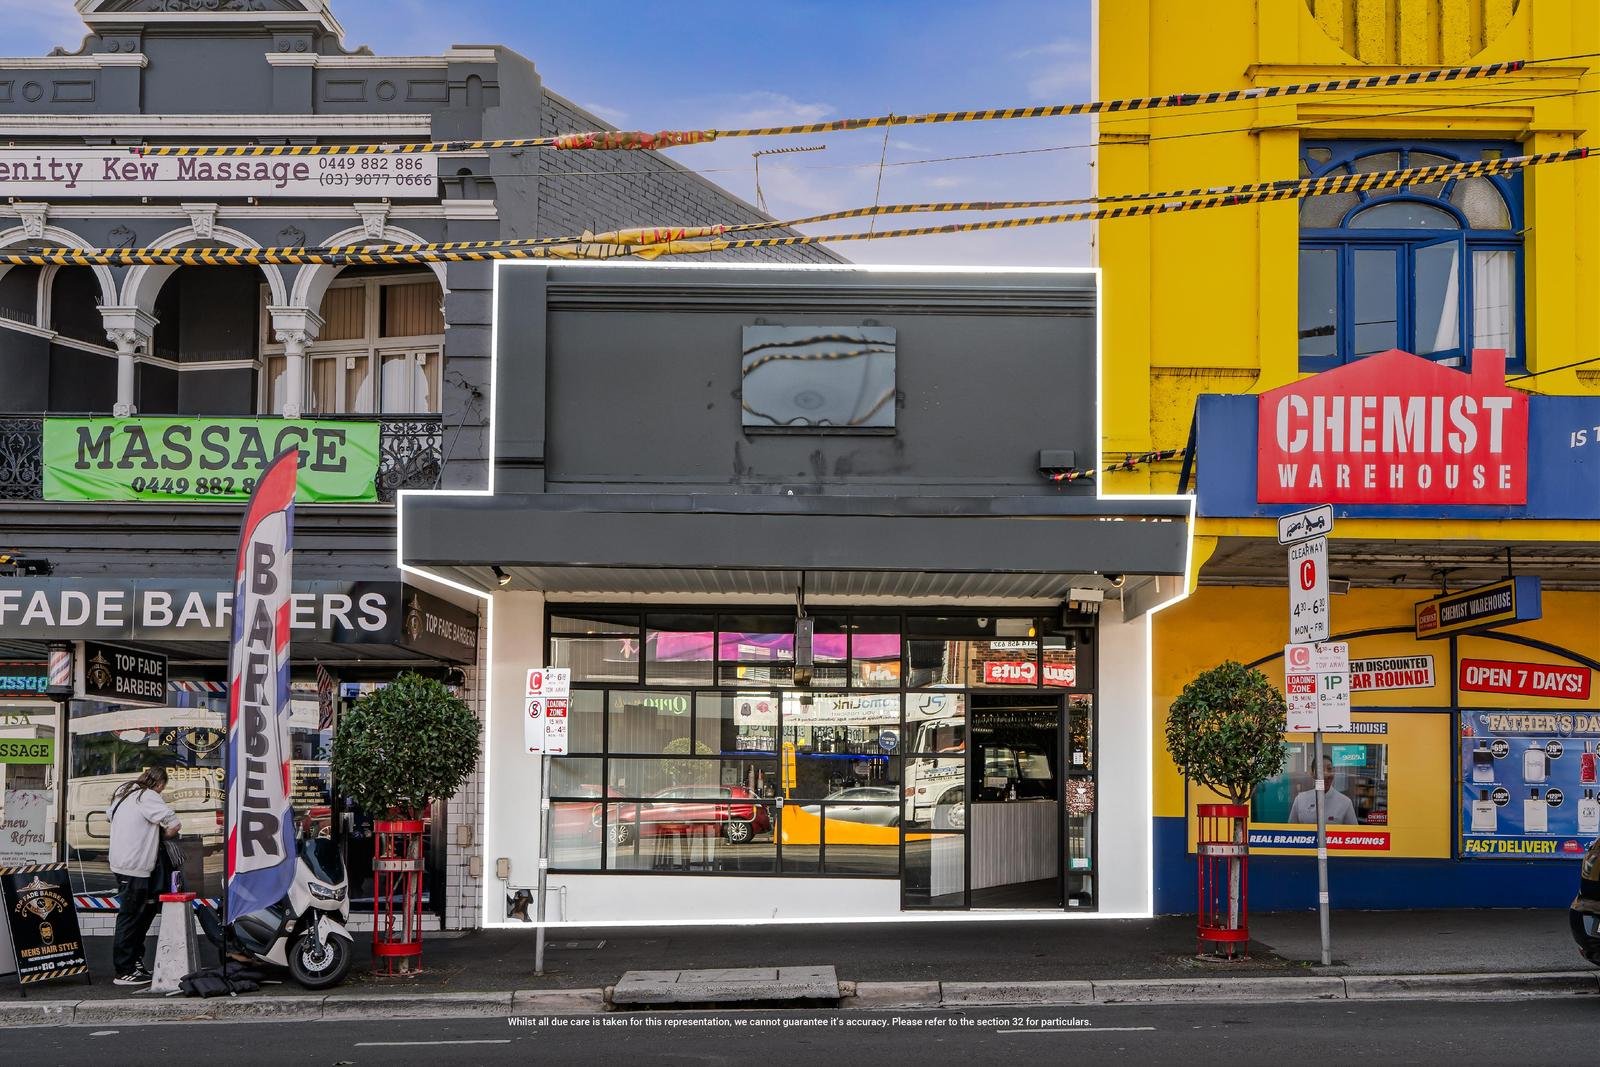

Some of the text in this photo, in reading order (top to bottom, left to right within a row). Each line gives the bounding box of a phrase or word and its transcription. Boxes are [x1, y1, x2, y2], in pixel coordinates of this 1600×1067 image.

[102, 157, 159, 181] Kew
[177, 157, 310, 188] Massage
[319, 157, 423, 170] 0449 882 886
[319, 173, 432, 187] (03) 9077 0666
[1276, 394, 1513, 454] CHEMIST
[1570, 429, 1587, 448] IS
[131, 476, 190, 493] 0449
[195, 477, 235, 495] 882
[1278, 464, 1511, 489] WAREHOUSE
[1291, 542, 1324, 560] CLEARWAY
[0, 590, 125, 626] FADE
[1441, 591, 1511, 622] CHEMIST WAREHOUSE
[425, 613, 476, 648] TOP FADE BARBERS
[115, 653, 136, 671] TOP
[138, 658, 163, 676] FADE
[1350, 657, 1428, 673] EM DISCOUNTED
[116, 676, 163, 698] BARBERS
[1287, 676, 1315, 685] LOADING
[1324, 675, 1343, 690] 1P
[1375, 669, 1430, 688] ROUND!
[1466, 666, 1583, 693] OPEN 7 DAYS!
[1291, 685, 1312, 693] ZONE
[240, 541, 280, 857] BARBER
[549, 708, 564, 716] ZONE
[1489, 713, 1572, 733] FATHER'S
[0, 744, 49, 758] SSAGE
[1249, 835, 1272, 843] REAL
[1273, 836, 1315, 845] BRANDS!
[1344, 837, 1385, 846] SAVINGS
[1466, 840, 1498, 853] FAST
[1498, 840, 1558, 854] DELIVERY
[23, 890, 39, 902] FADE
[21, 947, 41, 958] MENS
[41, 945, 58, 955] HAIR
[58, 941, 79, 952] STYLE
